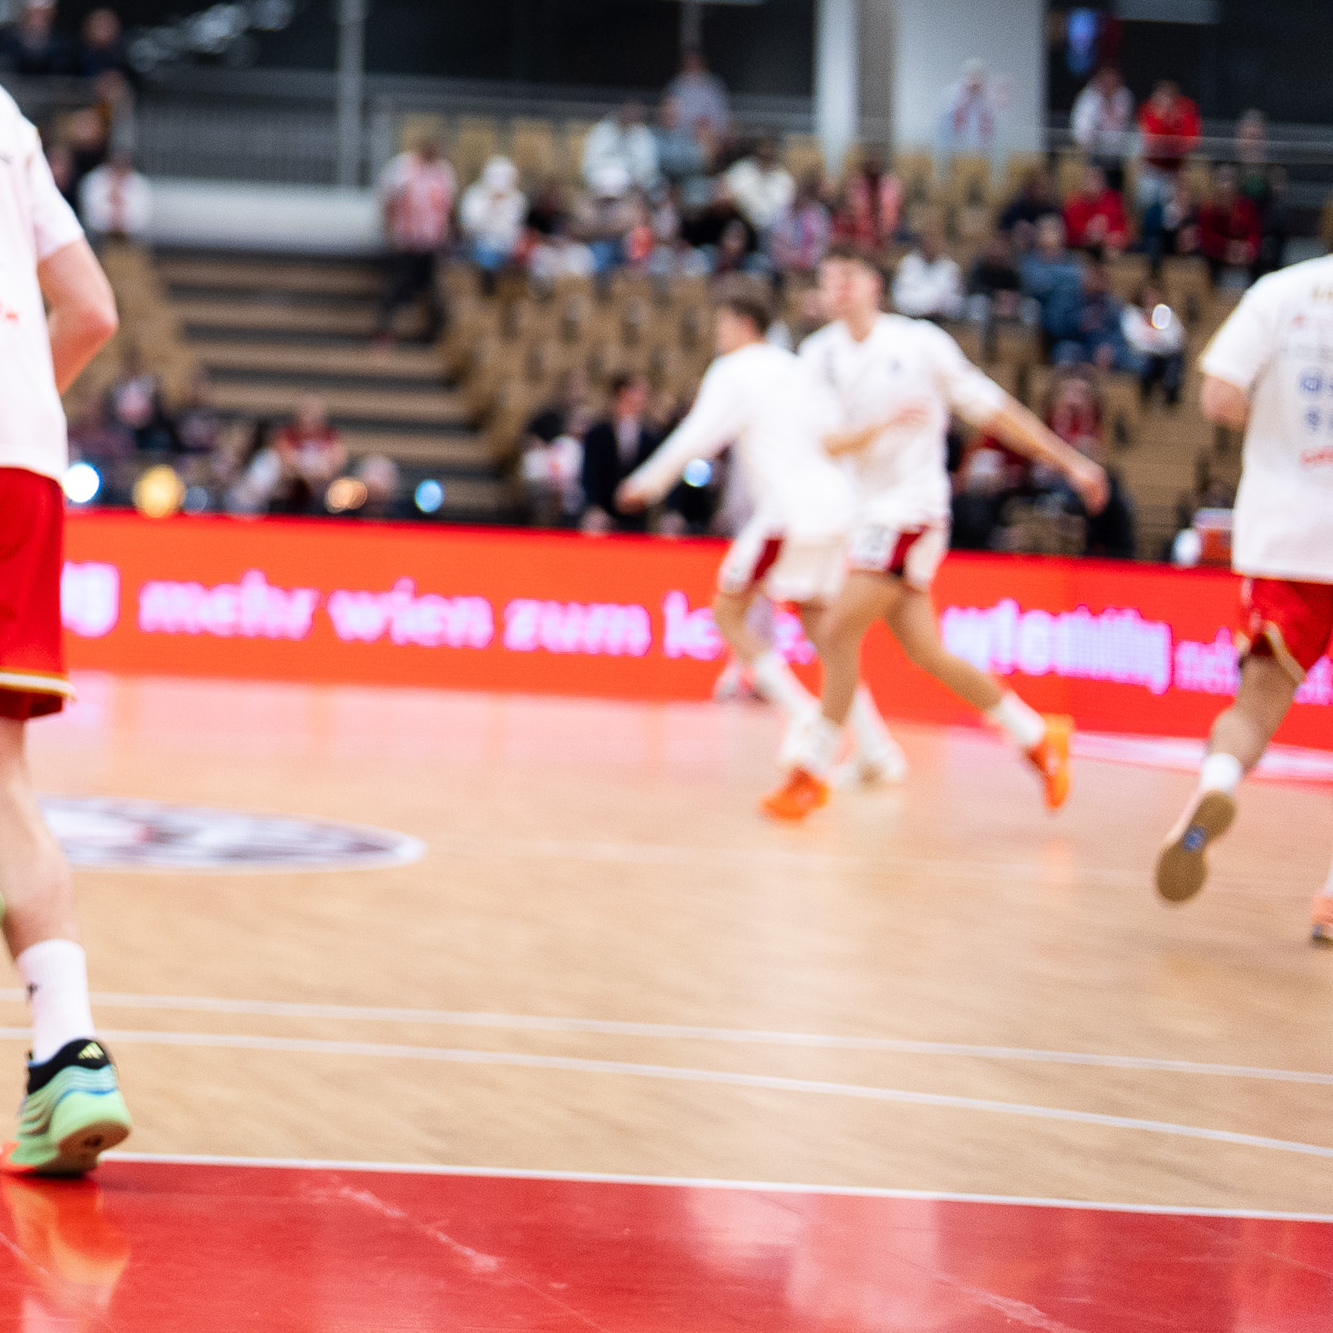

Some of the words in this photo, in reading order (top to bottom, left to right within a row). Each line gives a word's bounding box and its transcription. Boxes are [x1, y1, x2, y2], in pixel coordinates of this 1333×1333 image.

[138, 569, 320, 641] mehr
[326, 576, 494, 649] wien
[503, 597, 652, 657] zum
